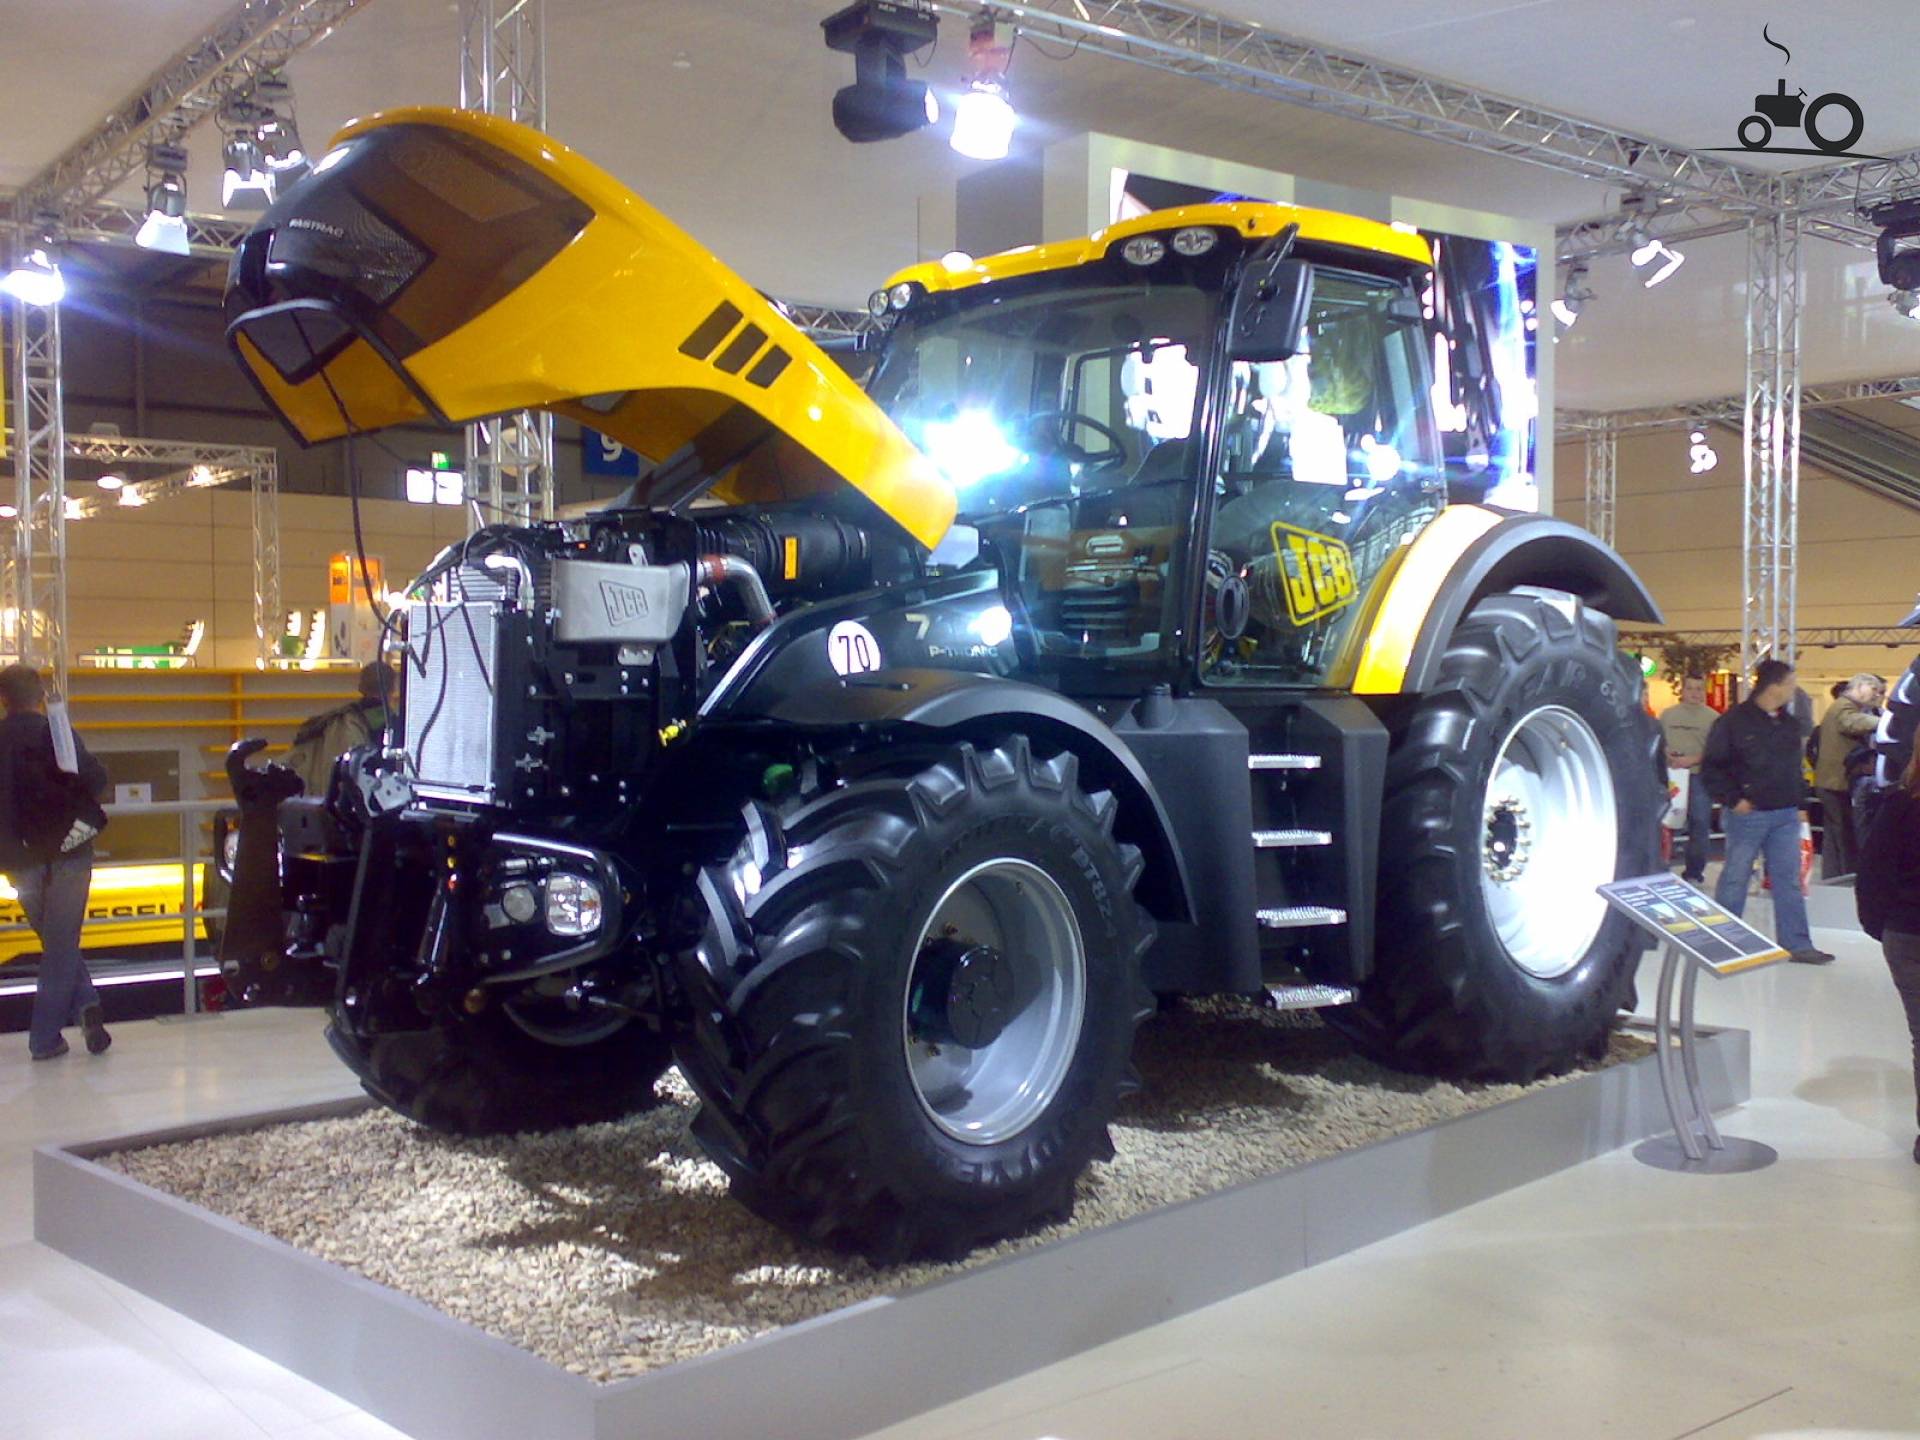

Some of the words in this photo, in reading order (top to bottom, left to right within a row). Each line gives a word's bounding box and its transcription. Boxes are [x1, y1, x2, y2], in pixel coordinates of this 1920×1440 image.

[600, 431, 623, 463] 9
[1282, 533, 1352, 614] JCB
[607, 585, 649, 622] JCB
[837, 634, 871, 672] 70
